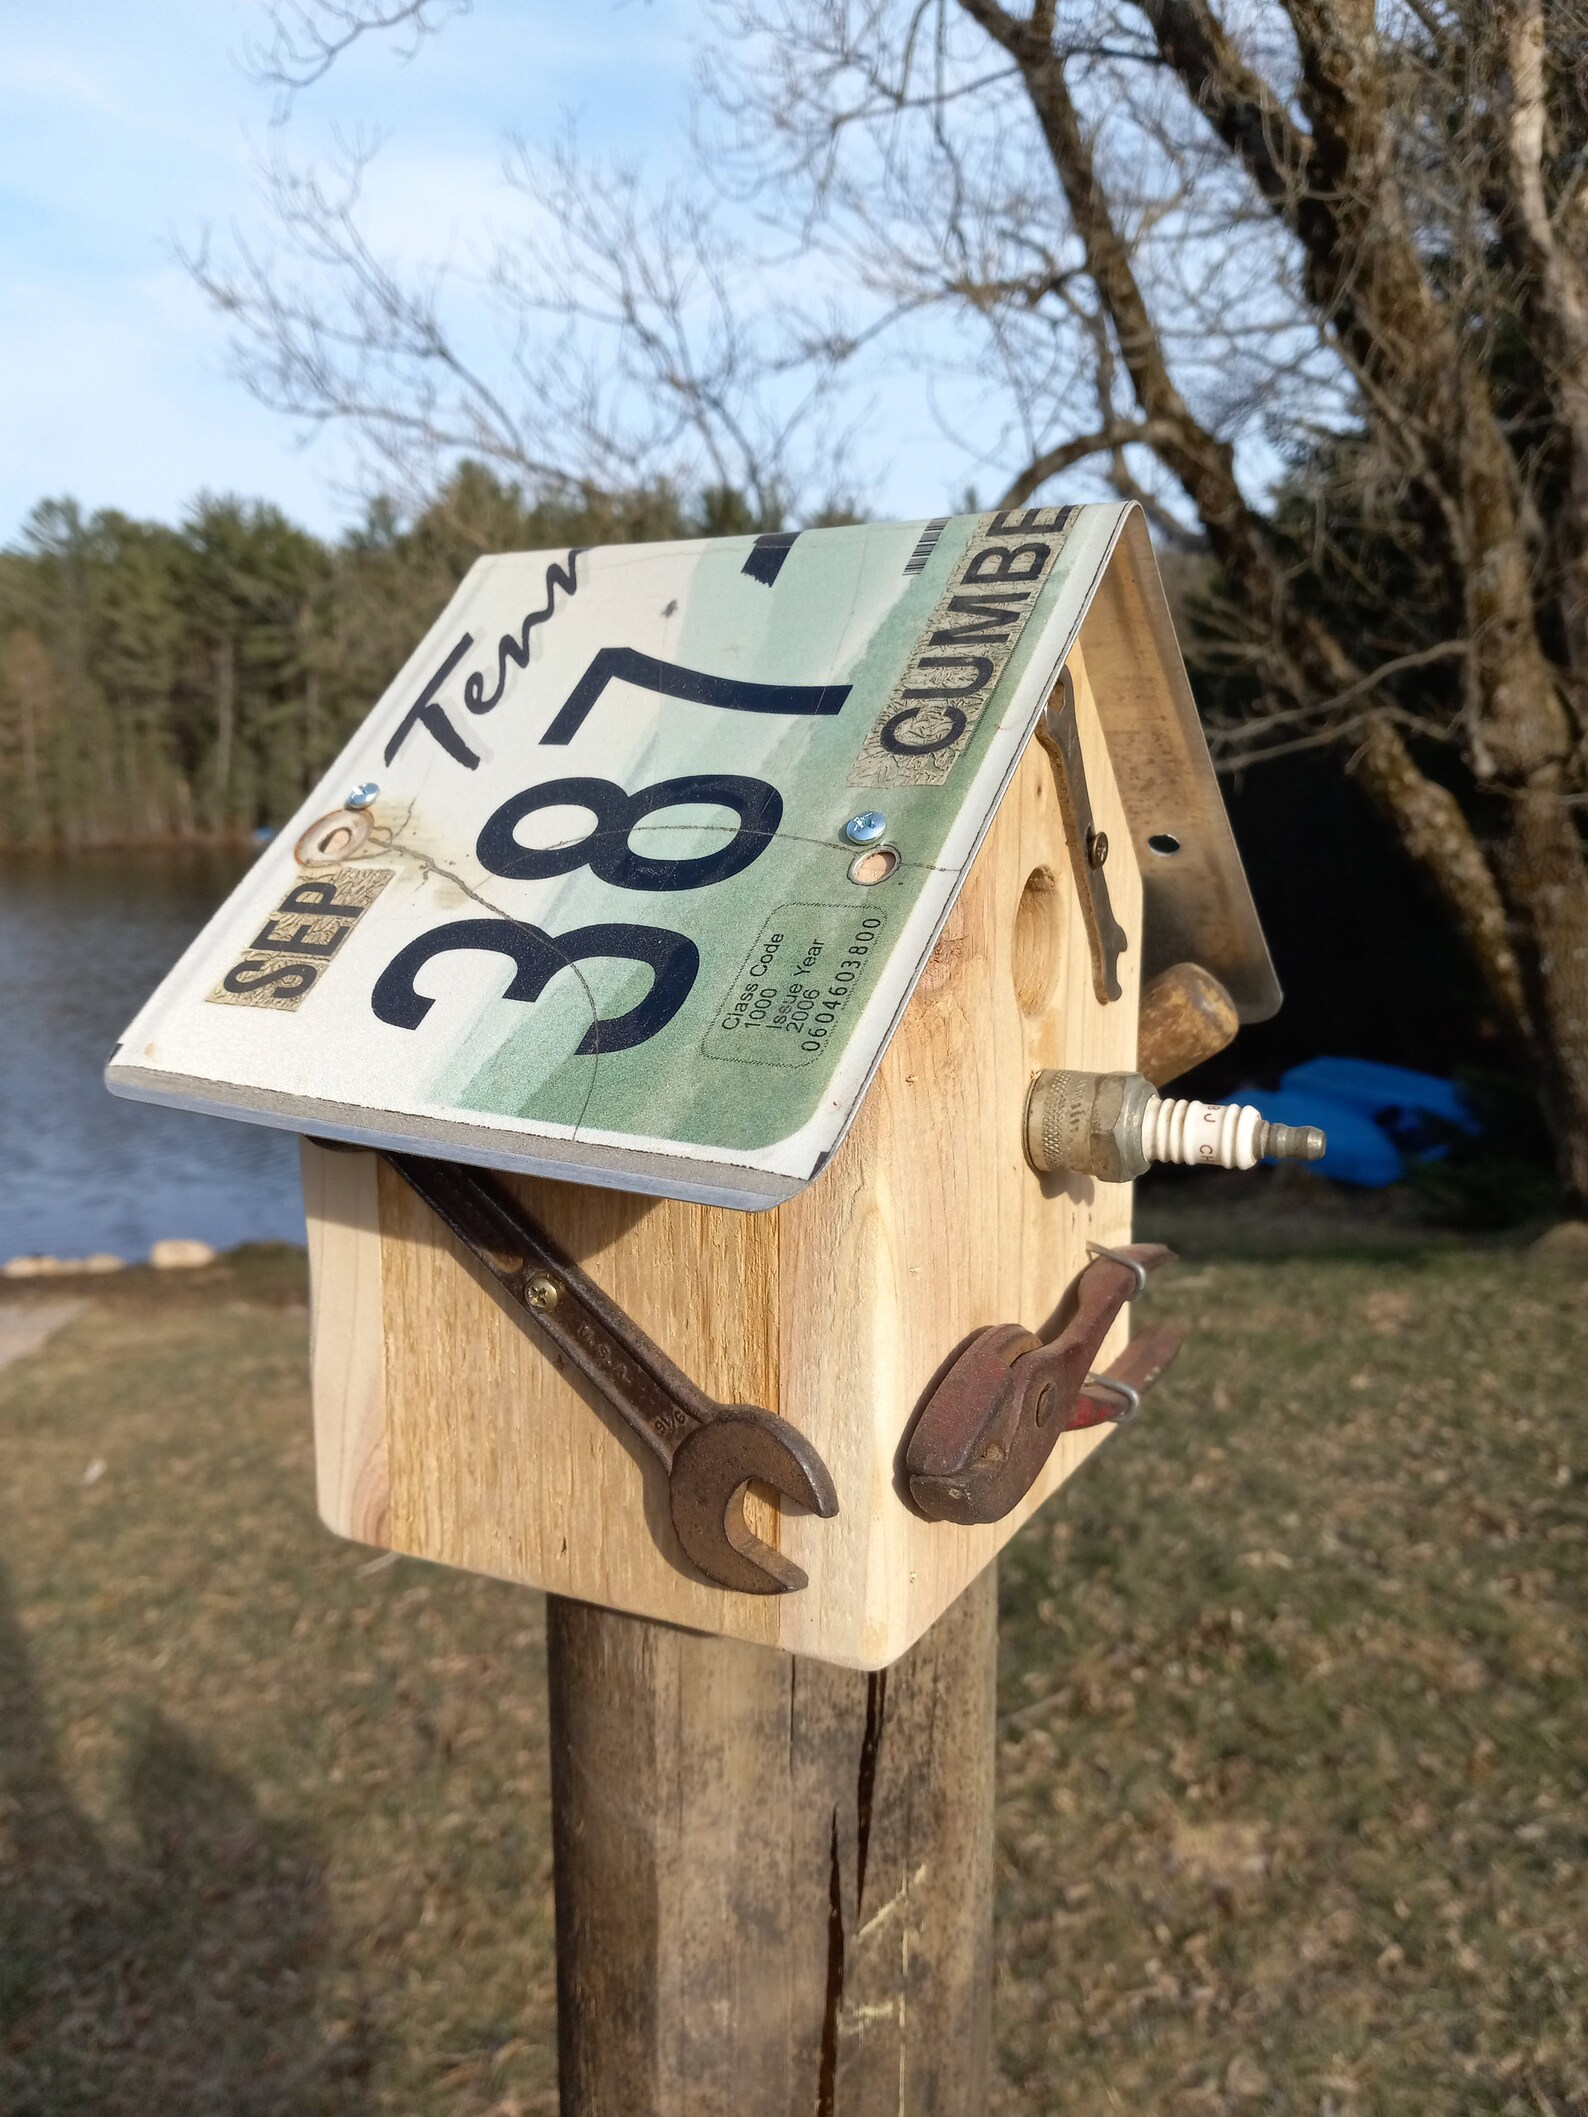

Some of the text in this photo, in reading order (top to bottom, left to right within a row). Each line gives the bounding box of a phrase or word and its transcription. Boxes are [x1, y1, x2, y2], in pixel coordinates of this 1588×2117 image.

[880, 504, 1077, 756] CUMBE
[371, 647, 853, 1055] 387
[224, 881, 363, 1000] SEP
[721, 933, 784, 1030] Class Code
[766, 938, 825, 1028] Issue Year
[801, 918, 881, 1052] 0604603800
[744, 988, 777, 1028] 1000
[786, 989, 820, 1032] 2006
